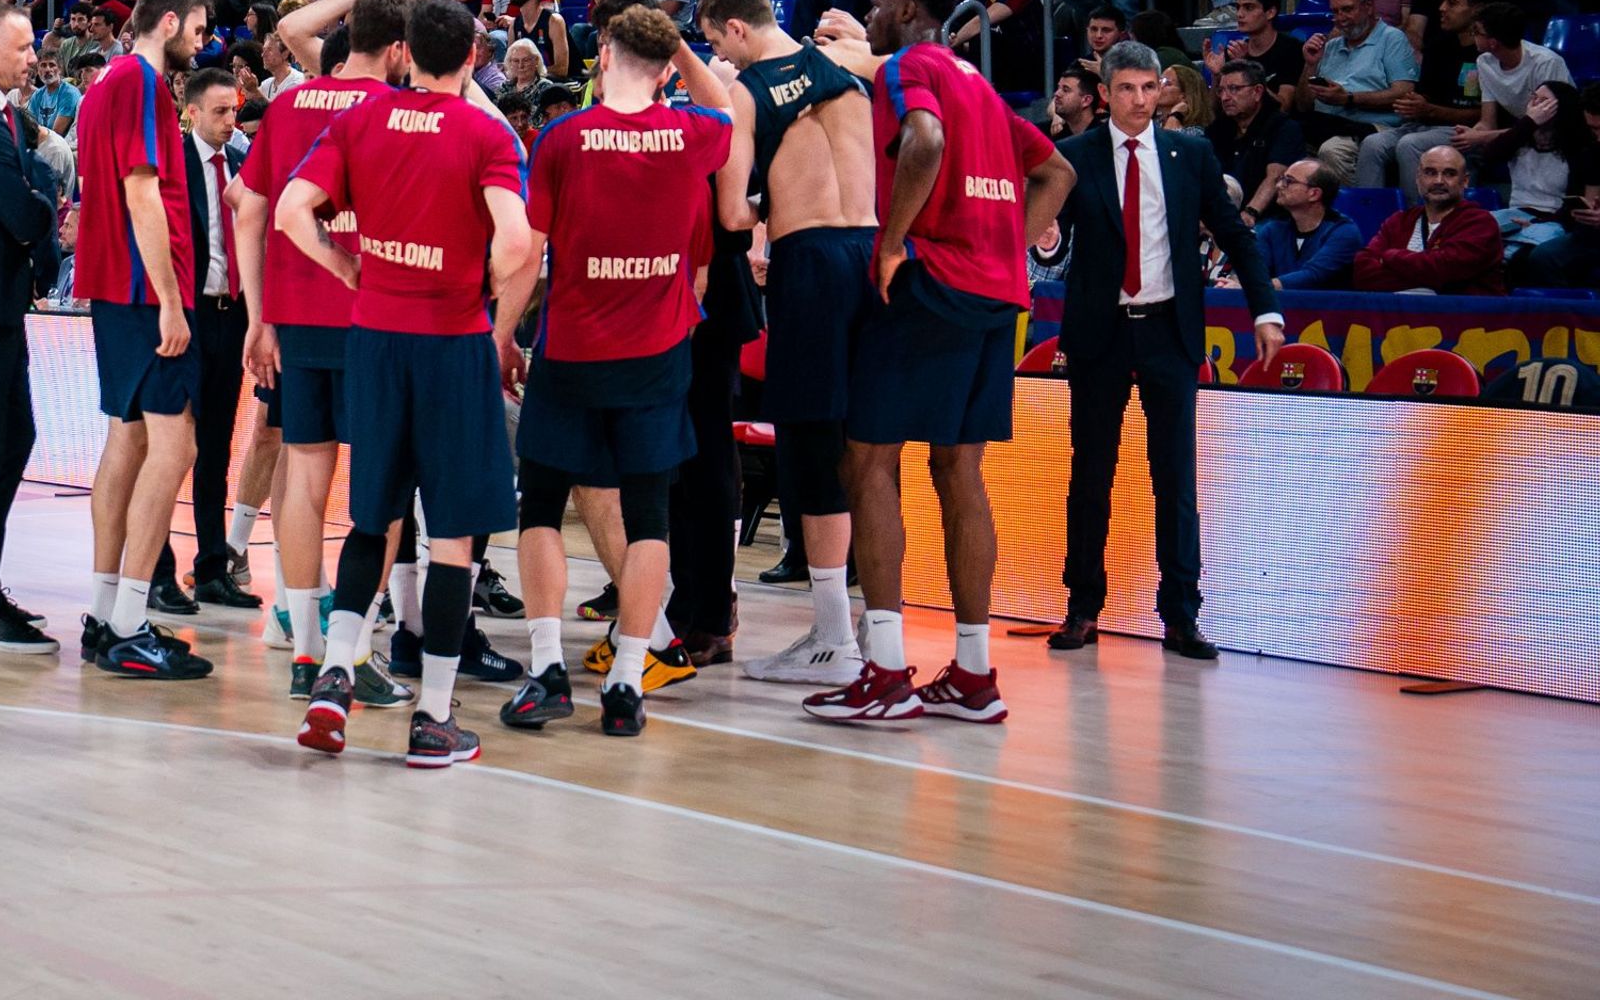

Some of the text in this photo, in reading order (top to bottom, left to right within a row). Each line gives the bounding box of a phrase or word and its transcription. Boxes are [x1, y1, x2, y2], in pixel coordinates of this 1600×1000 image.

[387, 107, 444, 134] KURIC
[580, 128, 685, 153] JOKUBAITIS
[1517, 360, 1579, 407] 10
